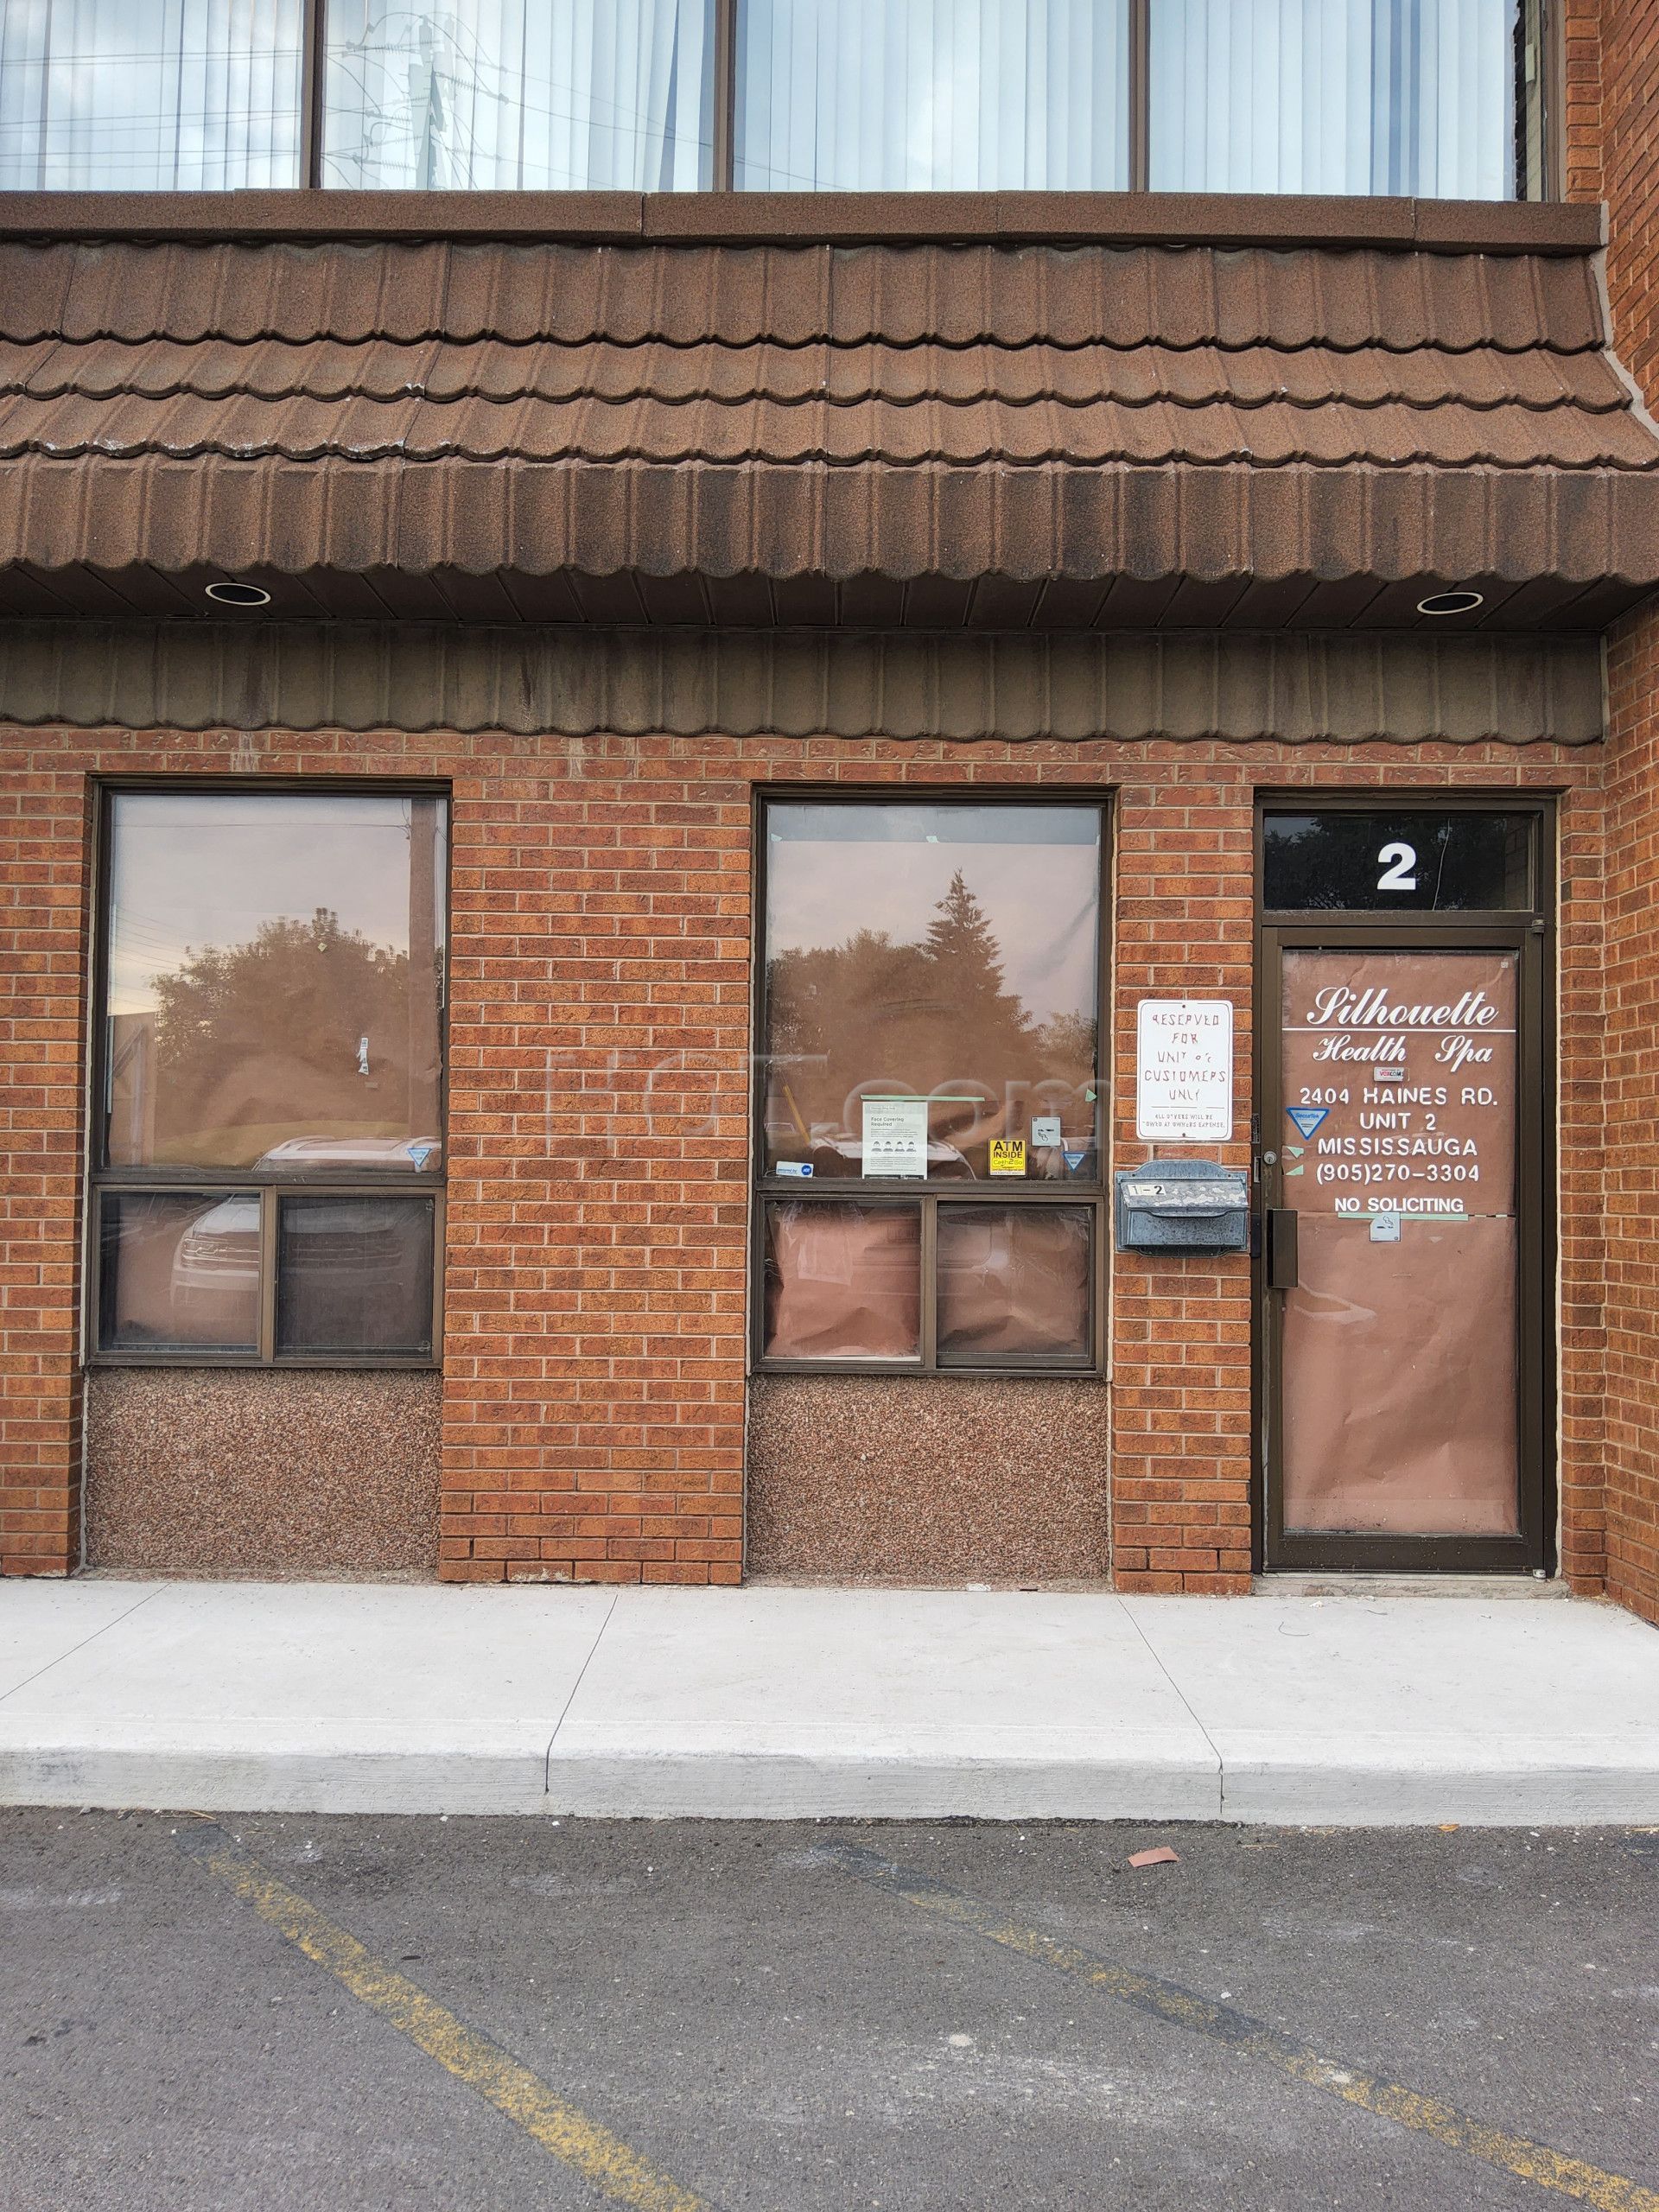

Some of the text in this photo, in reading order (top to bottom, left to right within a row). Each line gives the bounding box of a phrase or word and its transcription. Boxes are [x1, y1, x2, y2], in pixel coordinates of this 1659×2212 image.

[1376, 842, 1416, 890] 2
[1306, 987, 1498, 1026] Silhouette
[1153, 1014, 1219, 1026] RESERVED
[1172, 1033, 1198, 1044] FOR
[1313, 1034, 1493, 1072] Health Spa
[1144, 1071, 1226, 1082] CUSTOMERS
[1300, 1087, 1498, 1106] 2404 HAINES RD.
[1359, 1112, 1436, 1130] UNIT 2
[994, 1141, 1023, 1151] ATM
[1318, 1138, 1478, 1156] MISSISSAUGA
[1316, 1164, 1479, 1185] (905)270-3304
[1335, 1198, 1464, 1212] NO SOLICITING
